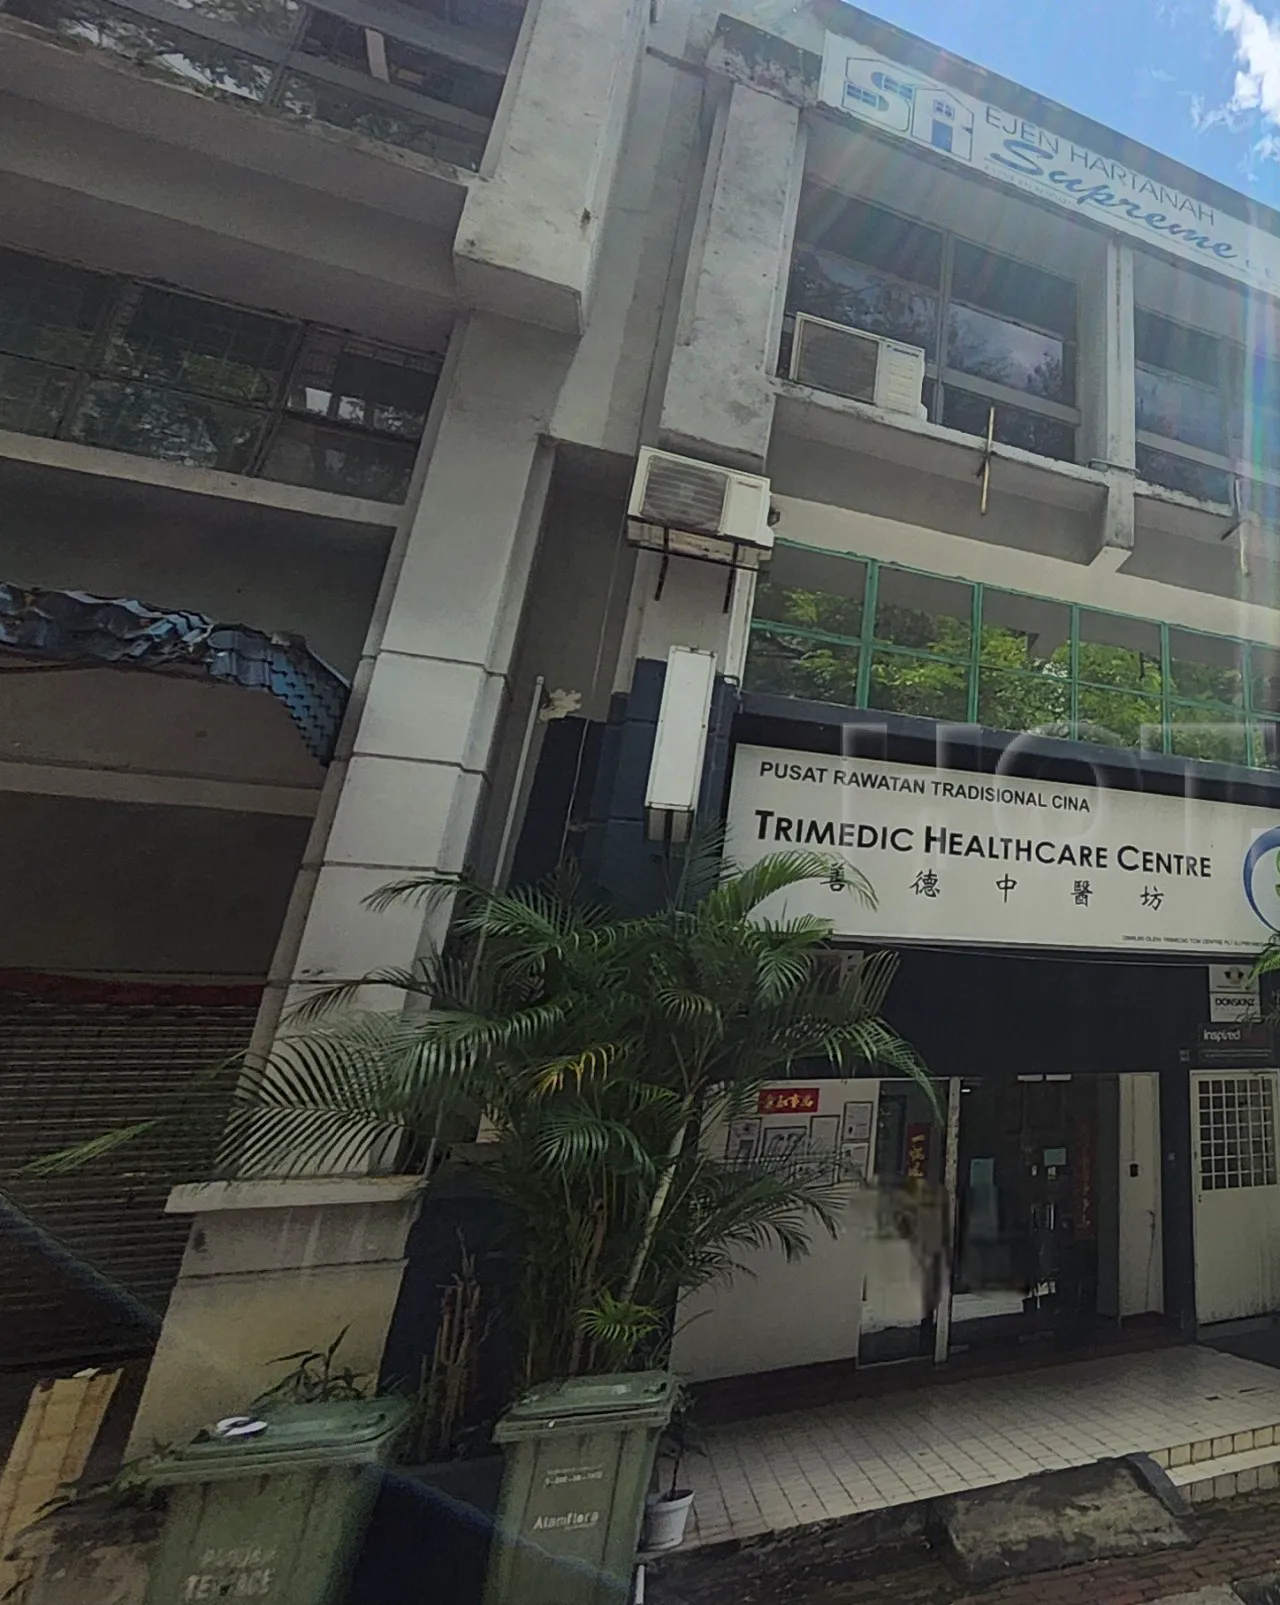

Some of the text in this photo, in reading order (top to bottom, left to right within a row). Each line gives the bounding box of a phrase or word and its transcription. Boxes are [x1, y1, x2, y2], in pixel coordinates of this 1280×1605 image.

[985, 106, 1059, 155] EJEN
[1070, 146, 1215, 226] HARTANAH
[989, 138, 1238, 259] Supreme
[760, 761, 1091, 813] PUSAT RAWATAN TRADISIONAL CINA
[755, 809, 1212, 878] TRIMEDIC HEALTHCARE CENTRE
